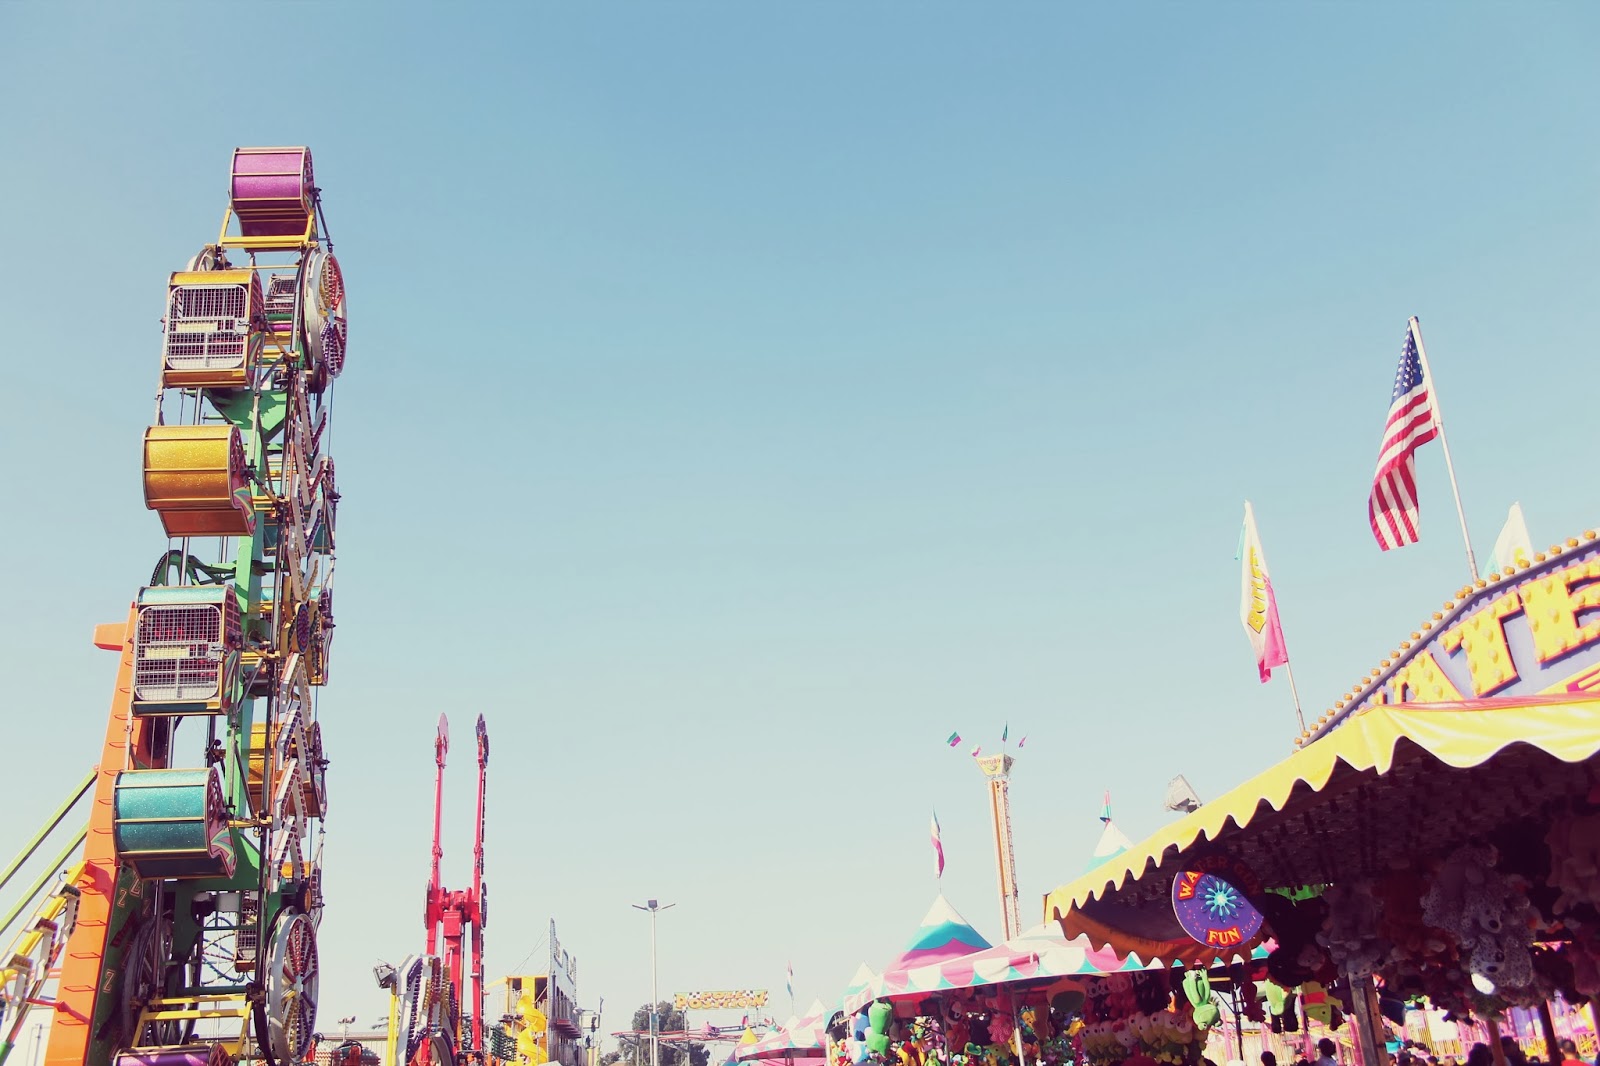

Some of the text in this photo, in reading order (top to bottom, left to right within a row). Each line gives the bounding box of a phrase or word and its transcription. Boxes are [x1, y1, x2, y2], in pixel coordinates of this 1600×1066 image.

[1179, 856, 1229, 899] WATER
[117, 888, 127, 908] Z
[1208, 927, 1241, 945] FUN
[102, 968, 116, 994] Z
[675, 991, 766, 1009] POSITION
[700, 990, 746, 1001] POLE
